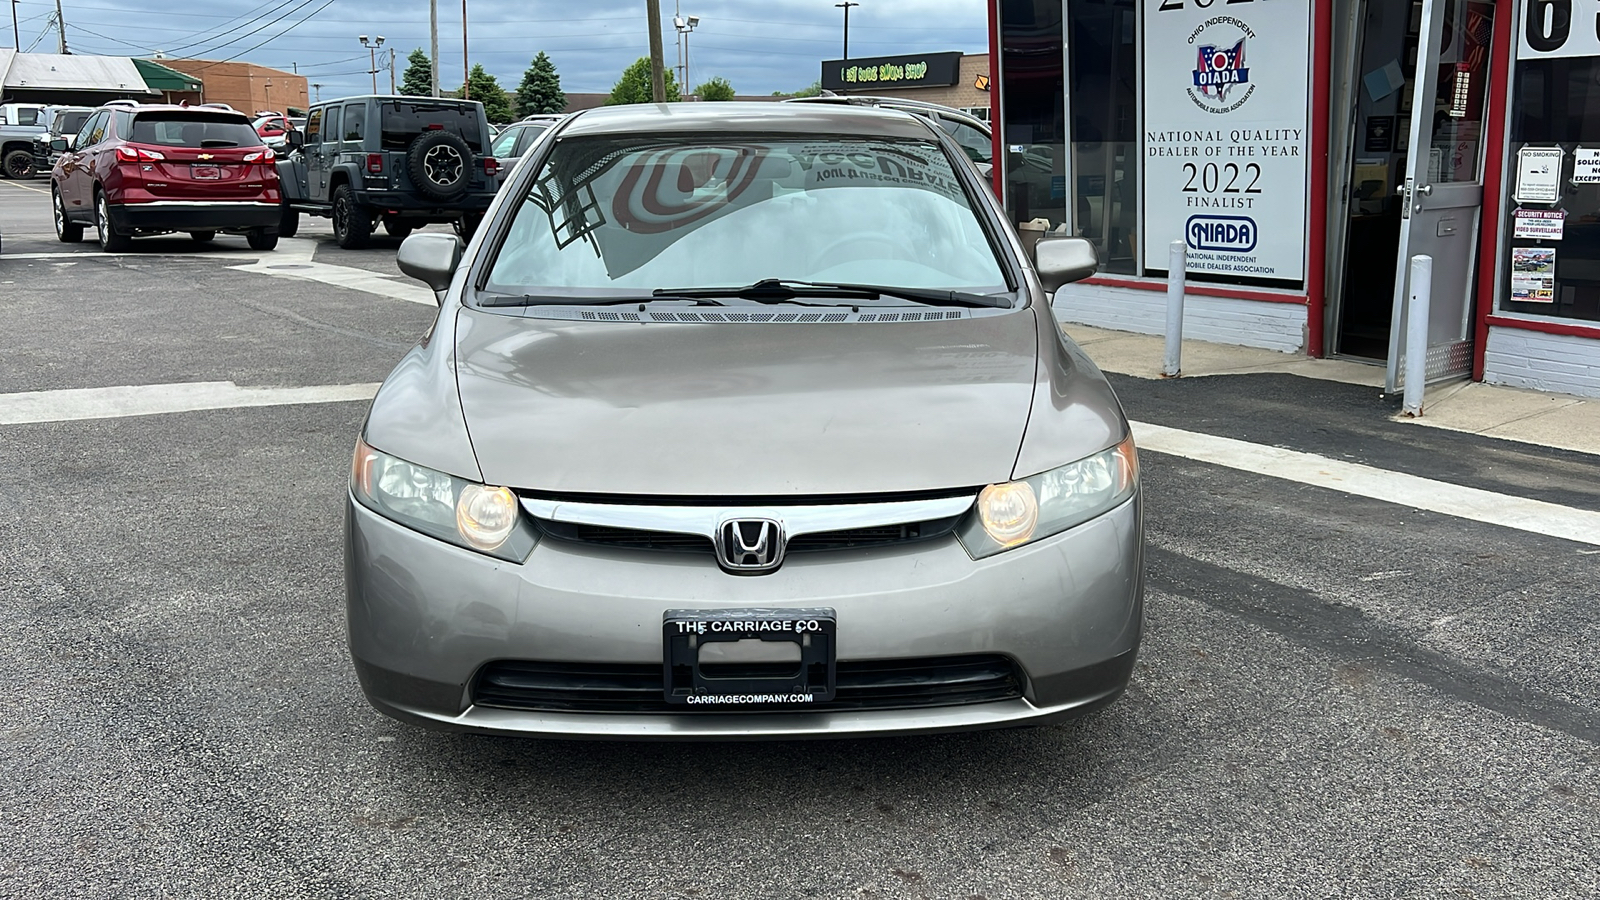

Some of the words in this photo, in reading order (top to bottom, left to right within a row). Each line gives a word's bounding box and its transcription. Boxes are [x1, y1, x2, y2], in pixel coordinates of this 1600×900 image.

[1187, 24, 1204, 44] OHIO
[1205, 16, 1256, 39] INDEPENDENT
[905, 61, 927, 80] SHOP
[1199, 70, 1239, 85] OIADA
[1186, 87, 1209, 112] AUTOMOBILE
[1230, 84, 1256, 111] ASSOCIATION
[1148, 130, 1223, 142] NATIONAL
[1230, 129, 1302, 143] QUALITY
[1149, 146, 1199, 157] DEALER
[1205, 146, 1222, 156] OF
[1228, 146, 1255, 156] THE
[1262, 146, 1299, 156] YEAR
[1181, 162, 1262, 194] 2022
[1187, 197, 1254, 209] FINALIST
[1517, 210, 1543, 218] SECURITY
[1543, 211, 1563, 219] NOTICE
[1191, 222, 1250, 244] NIADA
[1216, 254, 1257, 263] INDEPENDENT
[1207, 263, 1232, 271] DEALERS
[1233, 264, 1275, 274] ASSOCIATION
[676, 621, 707, 633] THE
[711, 620, 792, 632] CARRIAGE
[795, 619, 822, 633] CO.
[686, 694, 813, 704] CARRIAGECOMPANY.COM
